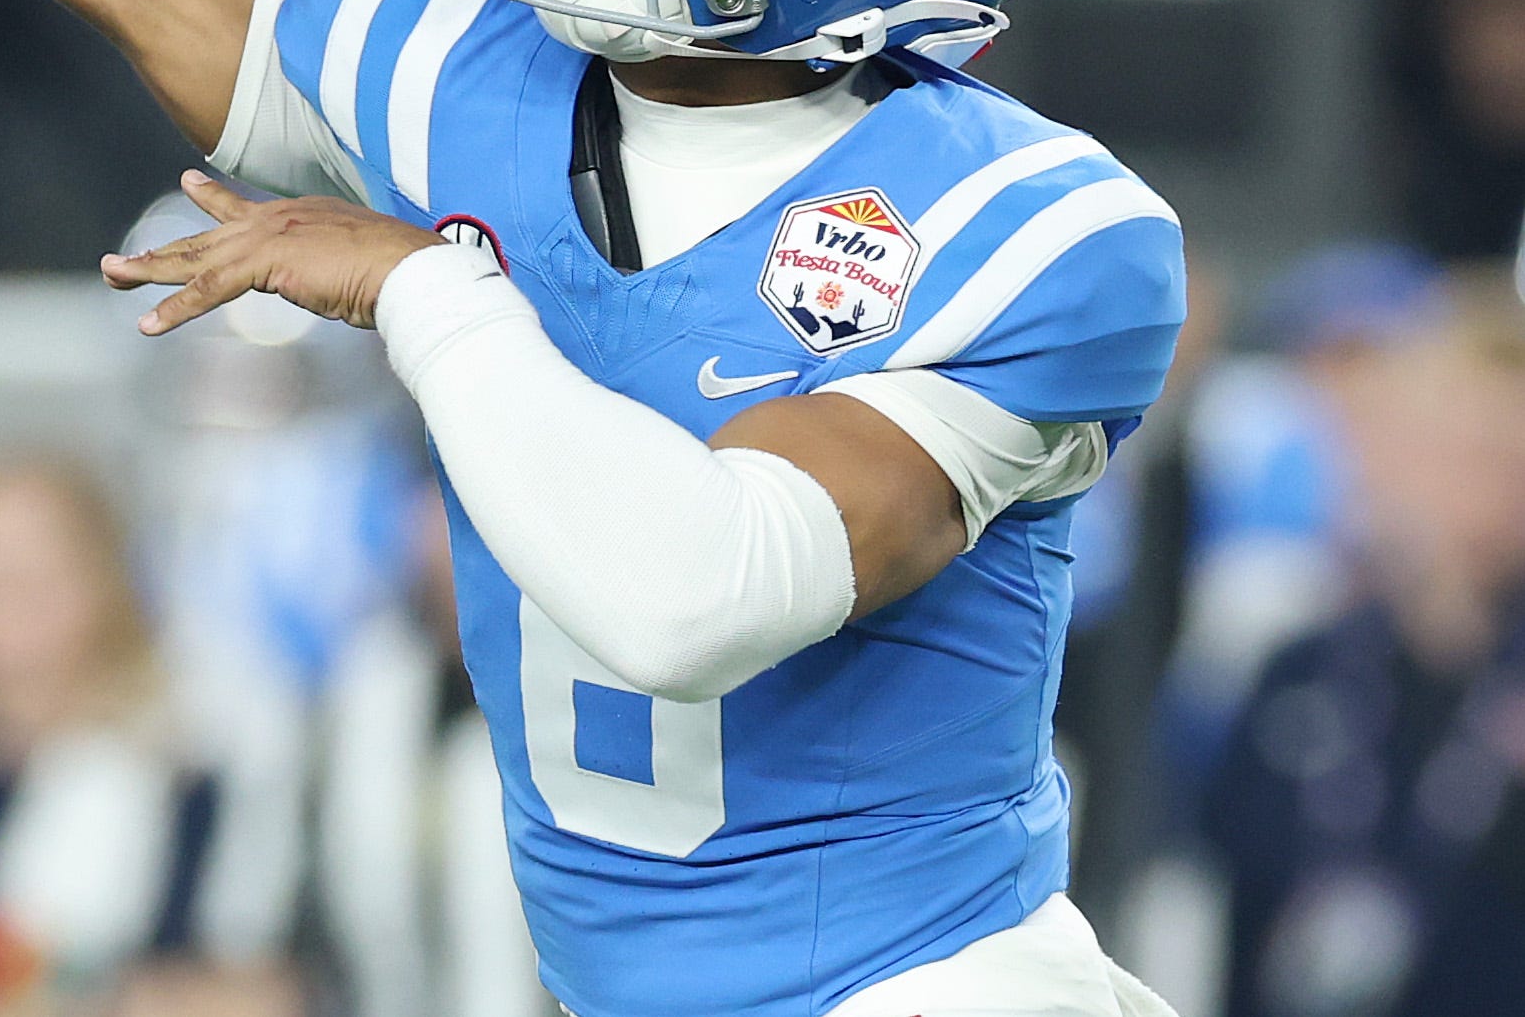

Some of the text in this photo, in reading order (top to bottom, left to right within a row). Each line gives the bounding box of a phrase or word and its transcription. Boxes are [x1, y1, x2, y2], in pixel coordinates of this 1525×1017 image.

[814, 221, 887, 262] Vrbo
[776, 249, 902, 300] Fiesta Bowl
